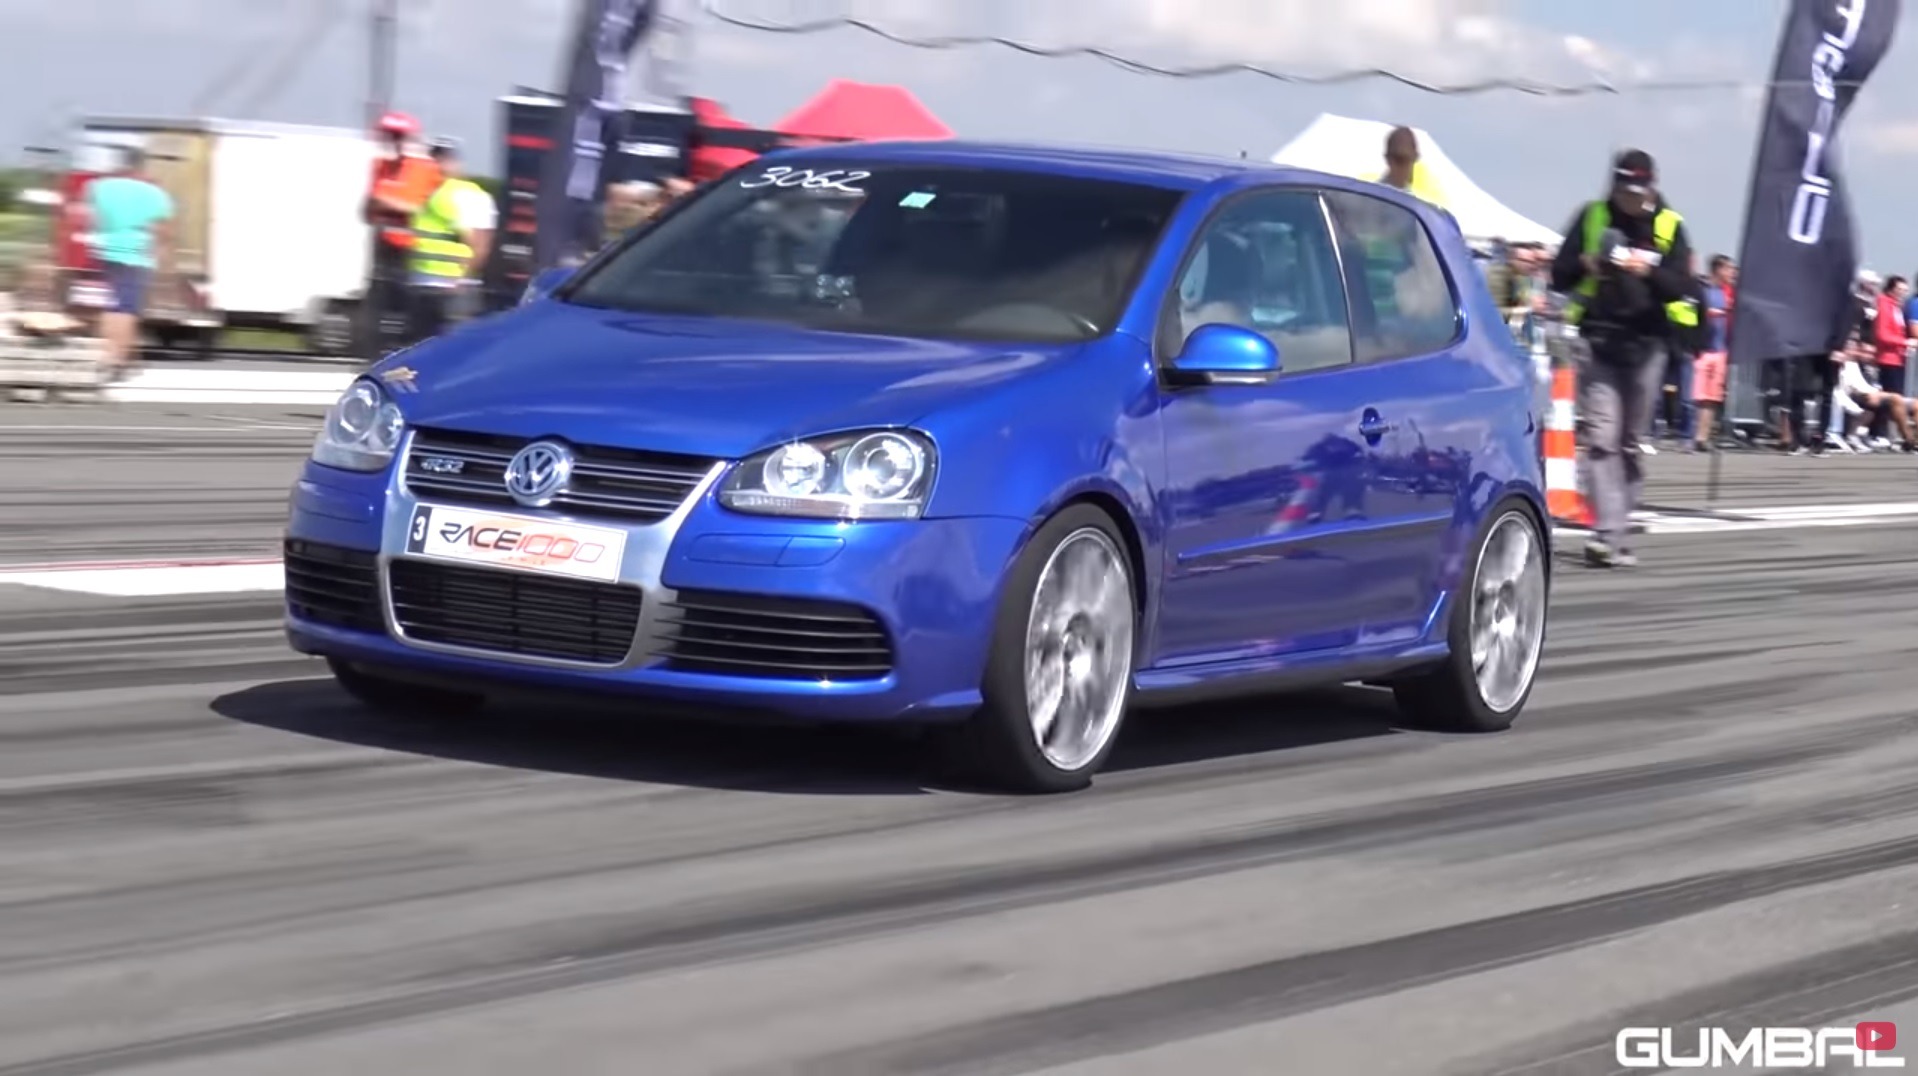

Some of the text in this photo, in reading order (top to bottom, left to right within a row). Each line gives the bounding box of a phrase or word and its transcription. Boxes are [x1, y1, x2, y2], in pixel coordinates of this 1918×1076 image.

[740, 166, 871, 192] 3062
[412, 516, 427, 541] 3
[439, 522, 605, 563] RACE1000
